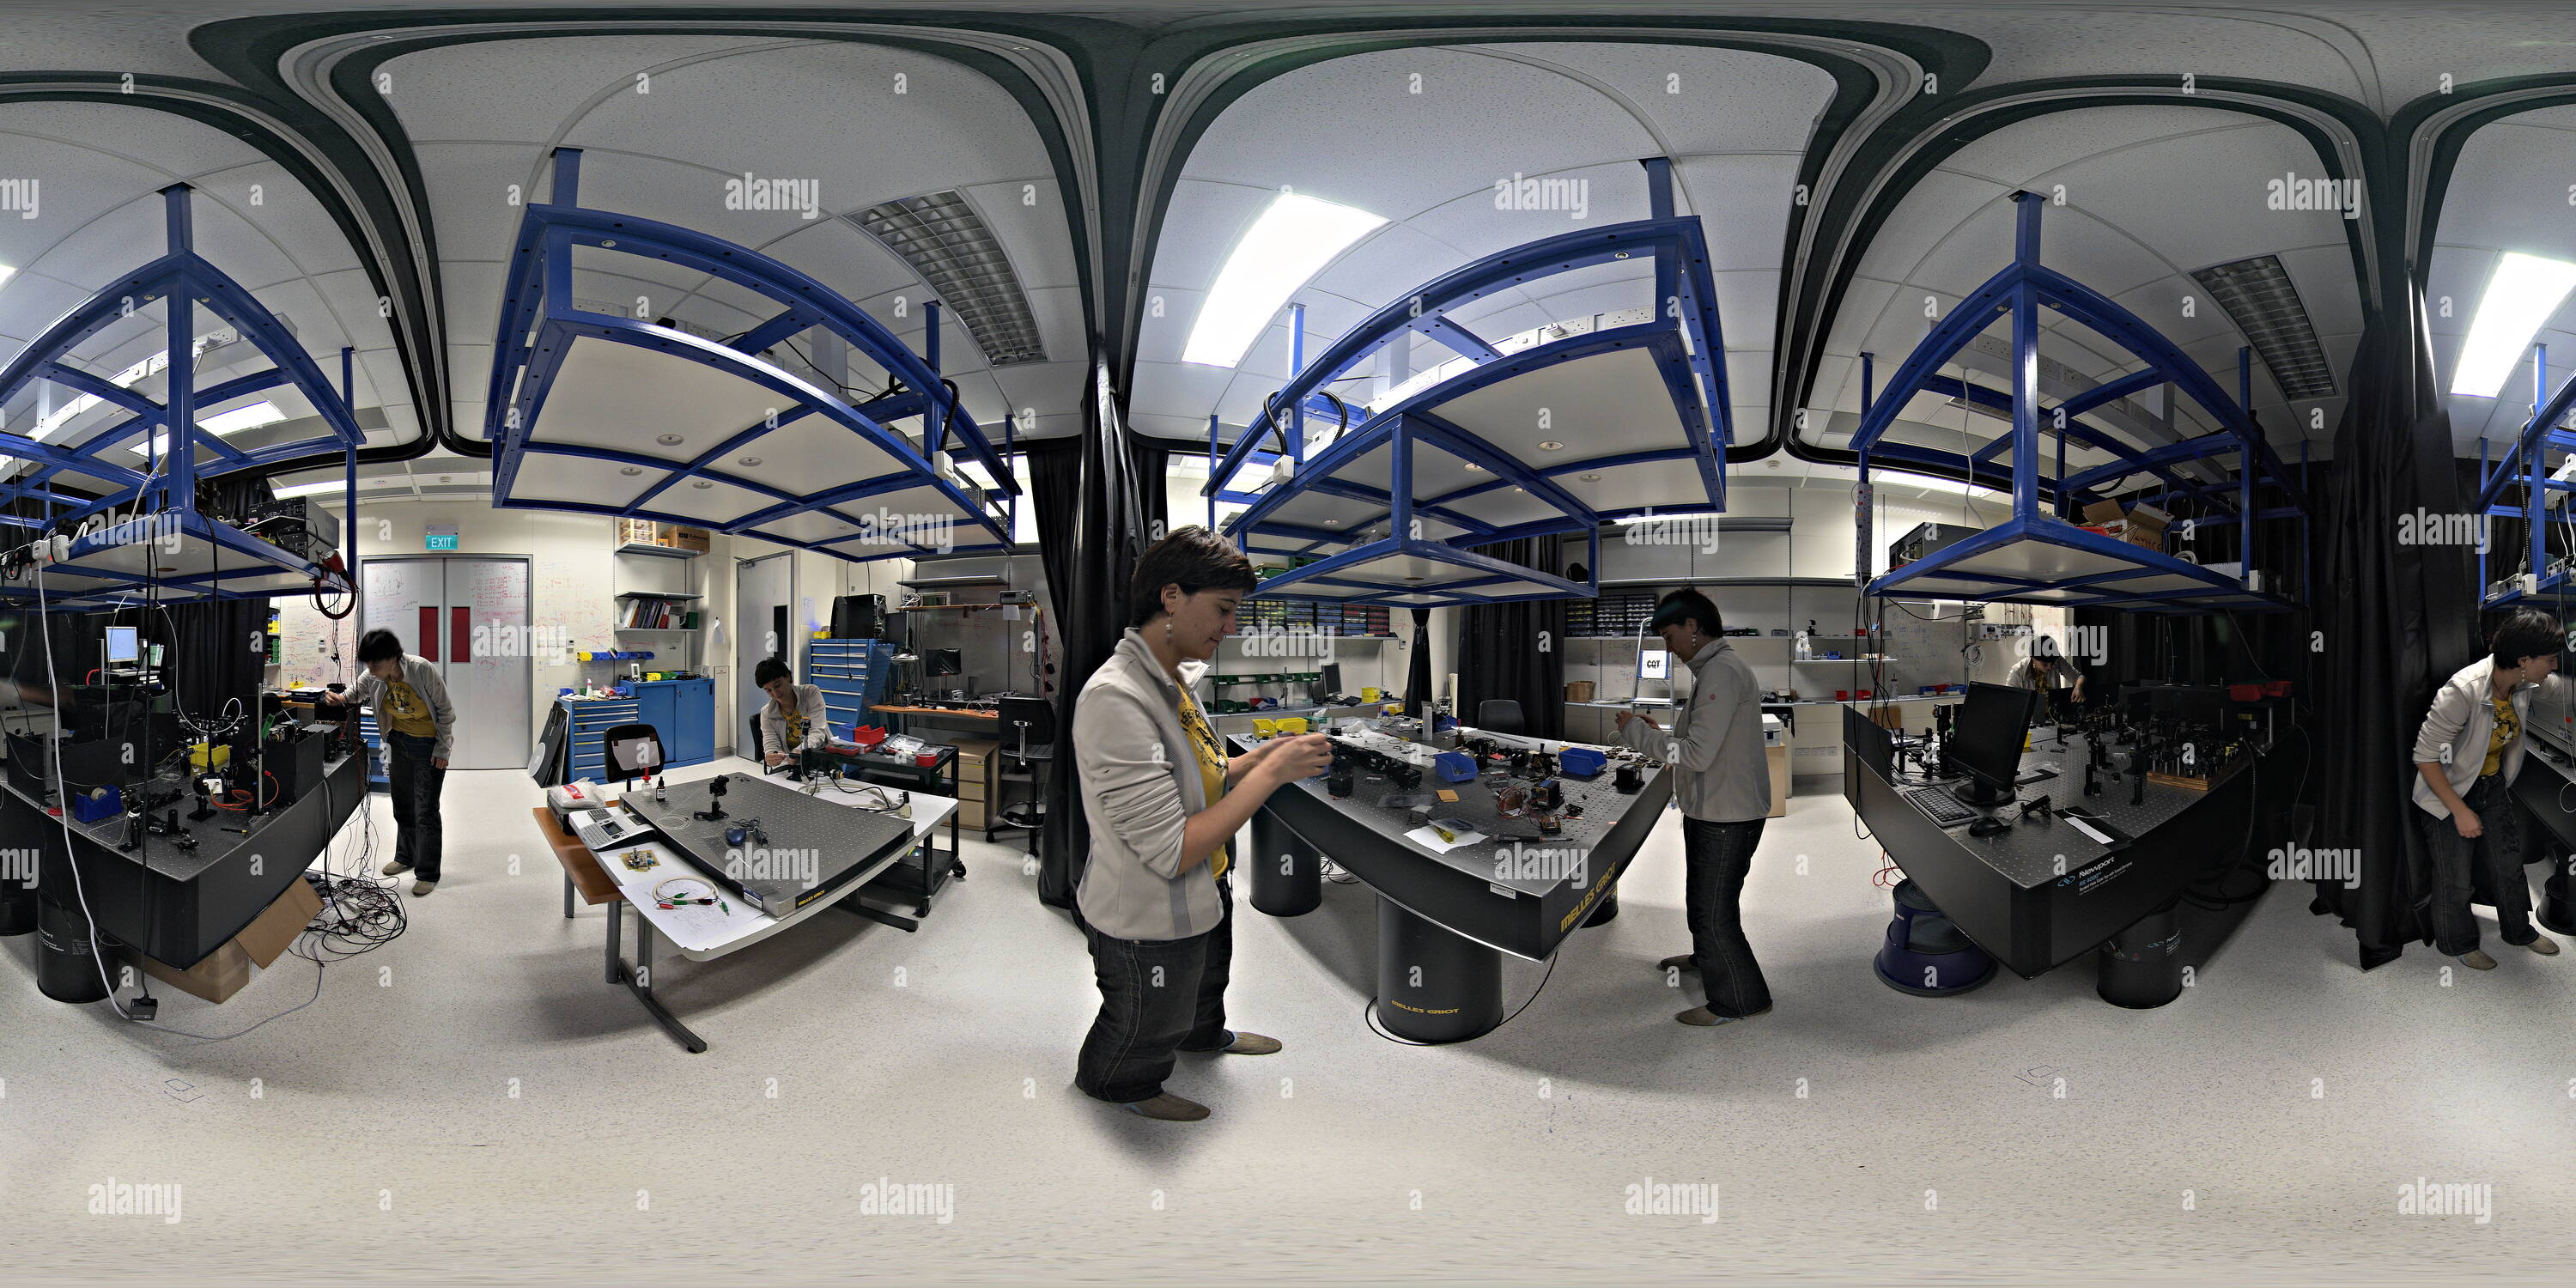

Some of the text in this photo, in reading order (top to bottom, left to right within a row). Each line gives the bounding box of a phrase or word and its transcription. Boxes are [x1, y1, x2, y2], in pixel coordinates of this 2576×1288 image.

[431, 537, 453, 548] EXIT
[1647, 660, 1661, 669] CQT
[2079, 857, 2115, 878] Newport
[1560, 888, 1595, 933] MELLES
[1595, 861, 1618, 893] GRIOT
[1391, 999, 1425, 1013] MELLES
